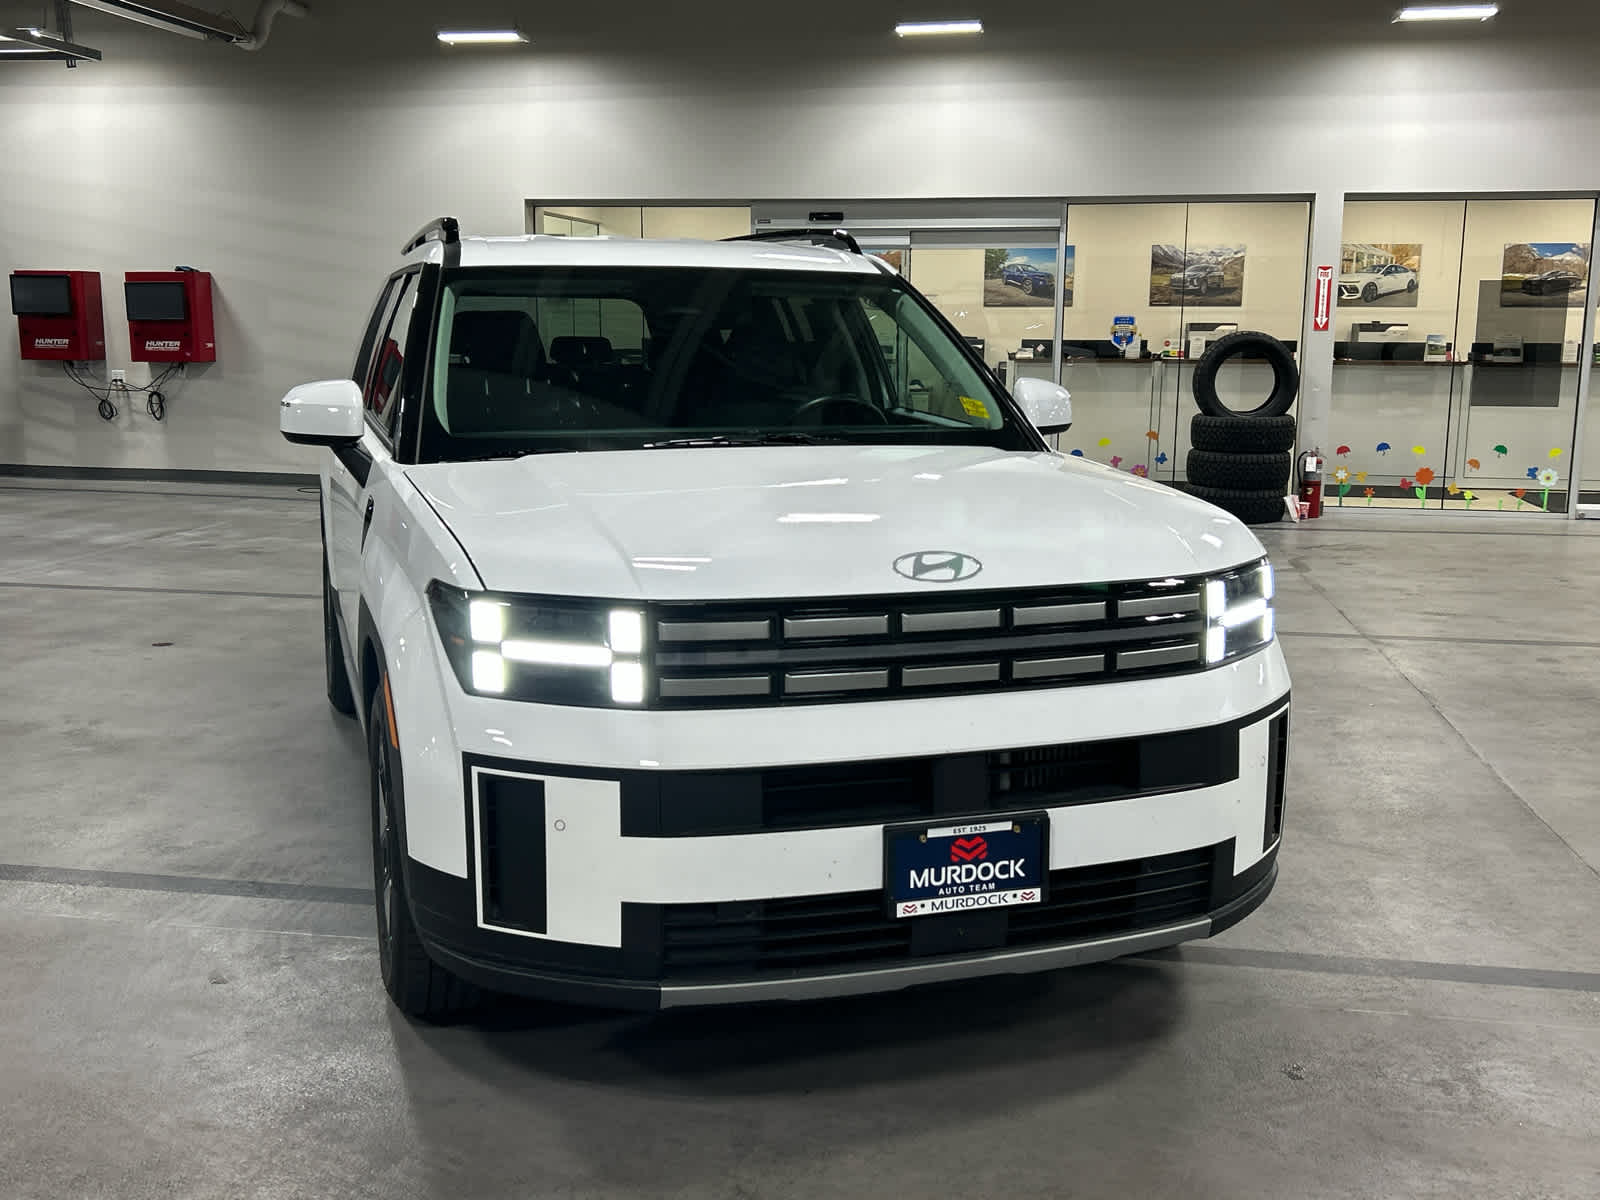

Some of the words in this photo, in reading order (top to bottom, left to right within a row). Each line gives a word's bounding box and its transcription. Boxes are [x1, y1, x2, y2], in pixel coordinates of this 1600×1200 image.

[909, 858, 1026, 889] MURDOCK
[938, 886, 966, 896] AUTO
[970, 882, 996, 892] TEAM
[931, 893, 1009, 912] MURDOCK
